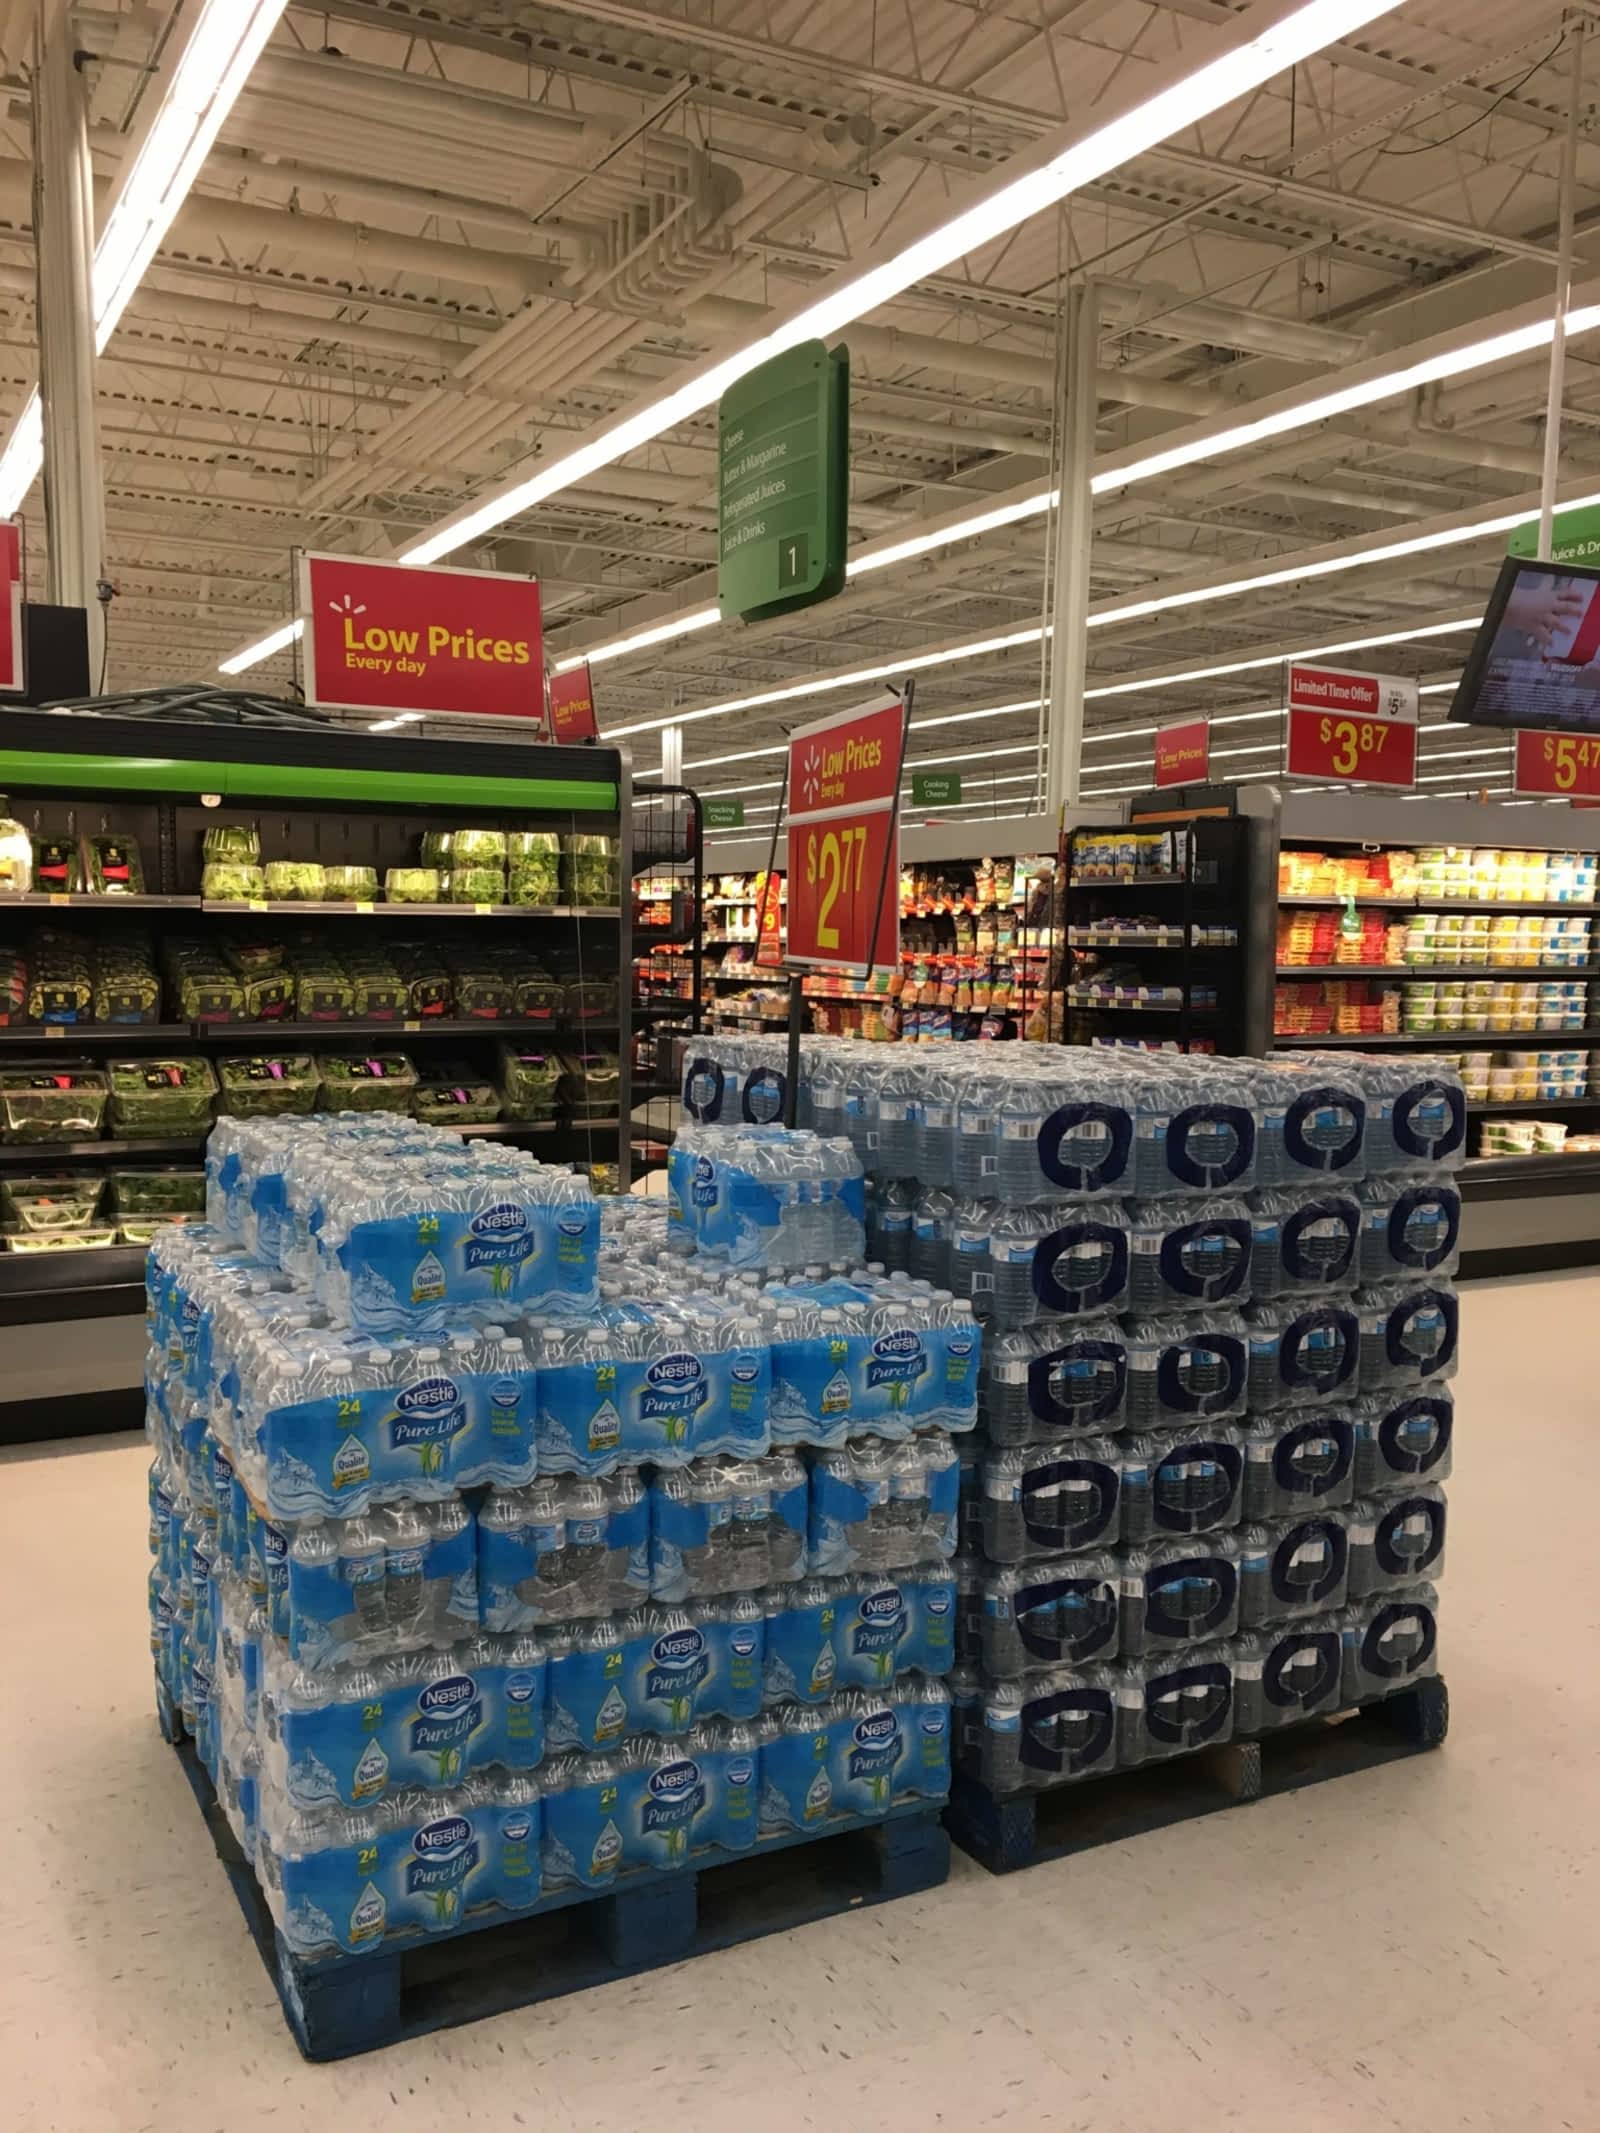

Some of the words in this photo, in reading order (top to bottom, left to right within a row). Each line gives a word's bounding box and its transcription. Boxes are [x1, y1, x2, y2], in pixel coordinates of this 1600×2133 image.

[1577, 543, 1586, 556] &
[788, 545, 796, 577] 1
[344, 618, 419, 655] Low
[428, 625, 529, 664] Prices
[346, 653, 392, 675] Every
[396, 655, 427, 677] day
[1294, 678, 1328, 696] Limited
[1328, 682, 1350, 699] Time
[1350, 686, 1374, 702] Offer
[821, 747, 843, 779] Low
[846, 736, 882, 773] Prices
[923, 780, 949, 790] Cooking
[925, 790, 948, 798] Cheese
[418, 1216, 439, 1233] 24
[476, 1210, 526, 1231] Nestlé
[468, 1244, 507, 1264] Pure
[508, 1239, 530, 1258] Life
[831, 1339, 848, 1353] 24
[597, 1366, 616, 1381] 24
[653, 1361, 698, 1379] Nestlé
[871, 1366, 905, 1381] Pure
[404, 1386, 454, 1406] Nestlé
[645, 1396, 681, 1413] Pure
[682, 1388, 704, 1409] Life
[337, 1400, 361, 1416] 24
[395, 1421, 435, 1440] Pure
[438, 1413, 463, 1434] Life
[659, 1635, 700, 1656] Nestlé
[606, 1652, 623, 1668] 24
[651, 1676, 682, 1692] Pure
[684, 1663, 705, 1684] Life
[426, 1682, 471, 1706] Nestlé
[363, 1704, 383, 1720] 24
[416, 1725, 452, 1744] Pure
[454, 1711, 477, 1740] Life
[601, 1786, 617, 1804] 24
[648, 1808, 680, 1825] Pure
[420, 1822, 467, 1848] Nestlé
[358, 1846, 378, 1864] 24
[411, 1867, 449, 1886] Pure
[450, 1853, 474, 1878] Life
